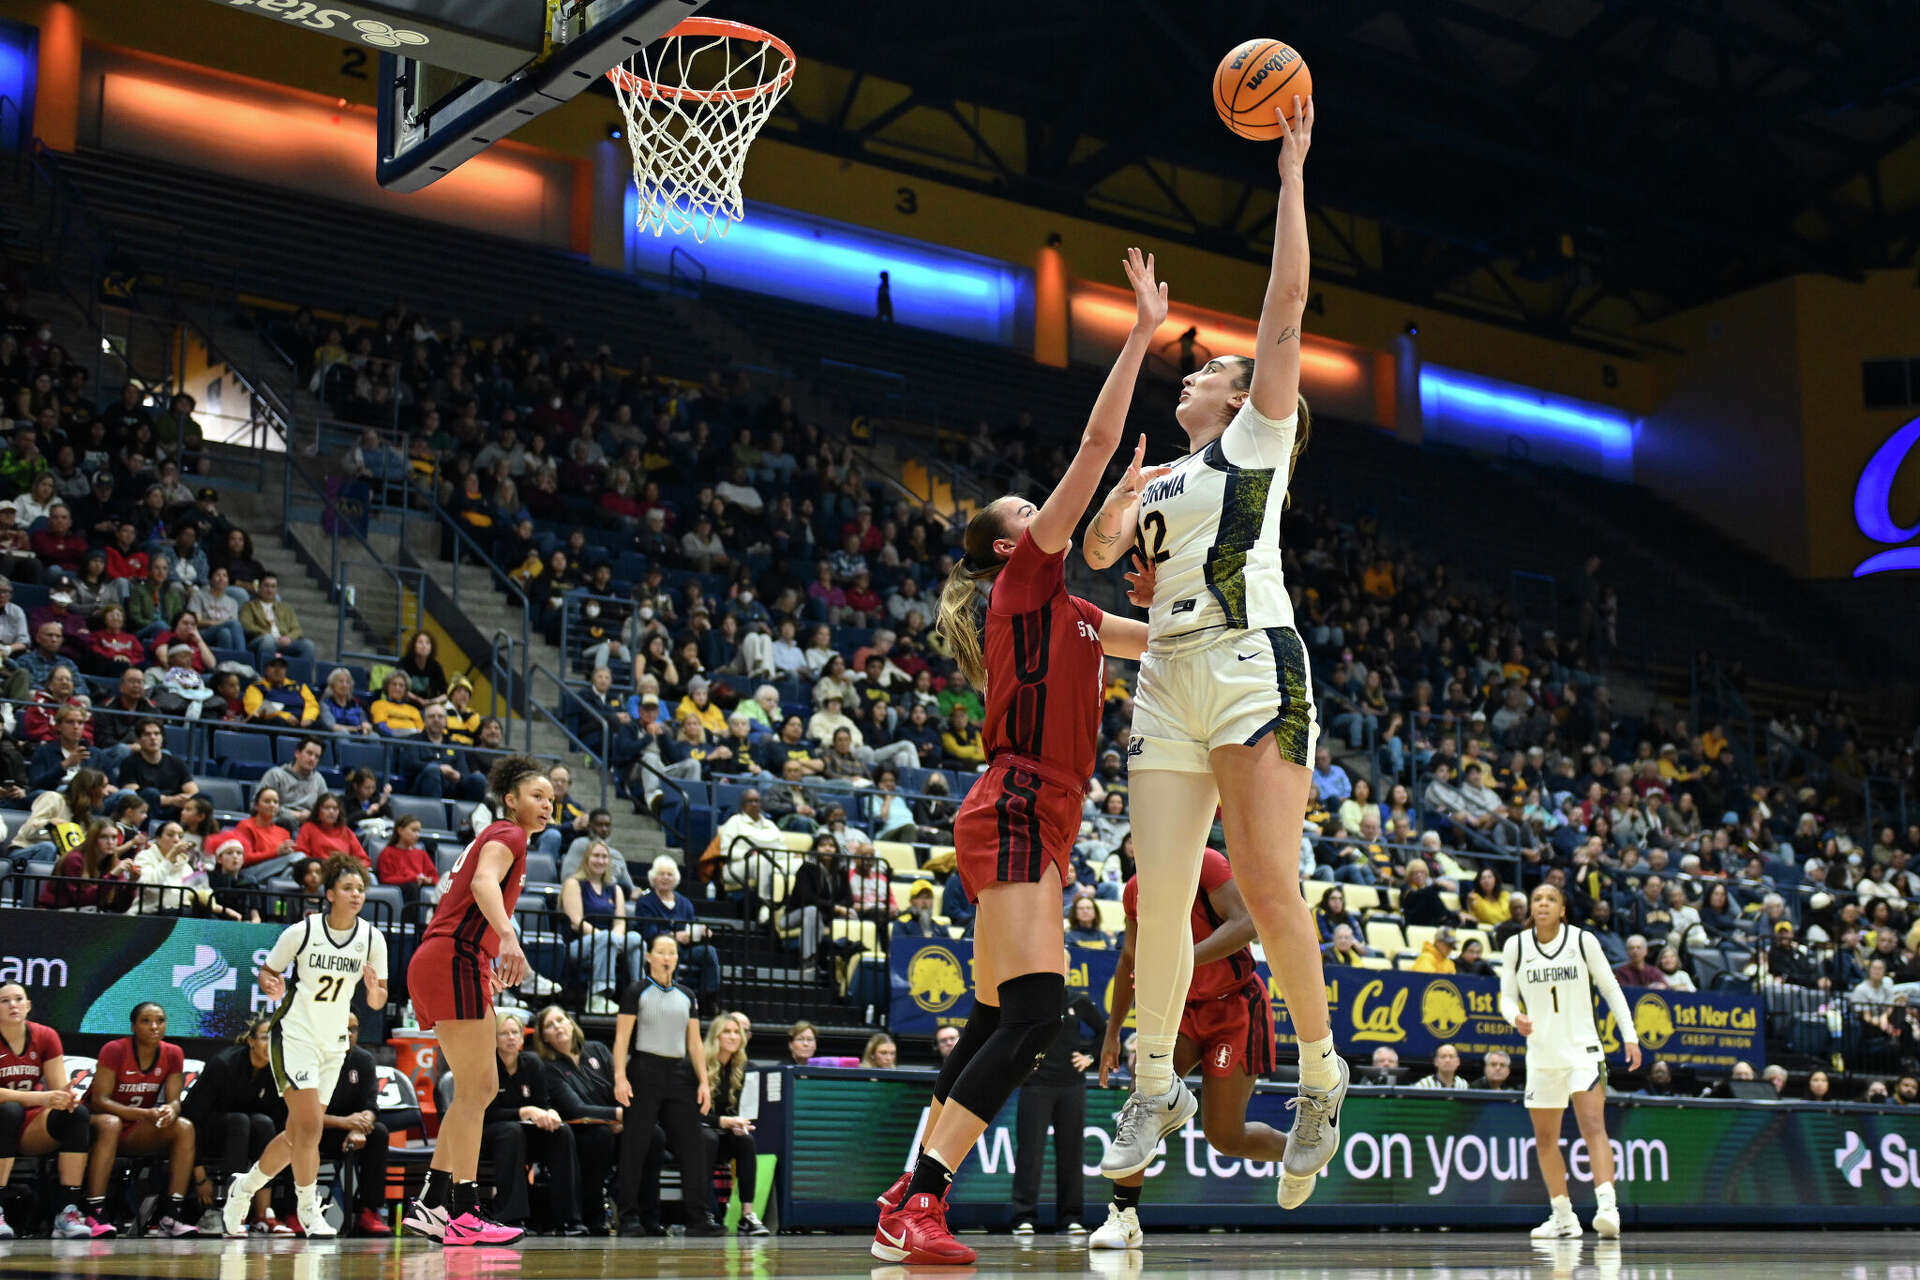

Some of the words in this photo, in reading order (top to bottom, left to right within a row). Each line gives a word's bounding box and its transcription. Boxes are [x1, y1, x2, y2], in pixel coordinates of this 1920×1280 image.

[227, 0, 351, 29] Sta
[341, 47, 368, 80] 2
[1246, 47, 1298, 90] Wilson
[896, 187, 917, 215] 3
[1141, 472, 1187, 507] ORNIA
[313, 975, 345, 1002] 21
[1066, 963, 1090, 987] al
[1526, 965, 1579, 984] CALIFORNIA
[1351, 979, 1409, 1043] Cal
[1467, 990, 1493, 1014] 1st
[1550, 985, 1560, 1014] 1
[1673, 1004, 1698, 1025] 1st
[1699, 1004, 1730, 1027] Nor
[1730, 1007, 1757, 1030] Cal
[1680, 1033, 1716, 1046] CREDIT
[1718, 1037, 1752, 1049] UNION
[415, 1047, 434, 1069] G
[1343, 1131, 1413, 1180] on
[1425, 1134, 1537, 1196] your
